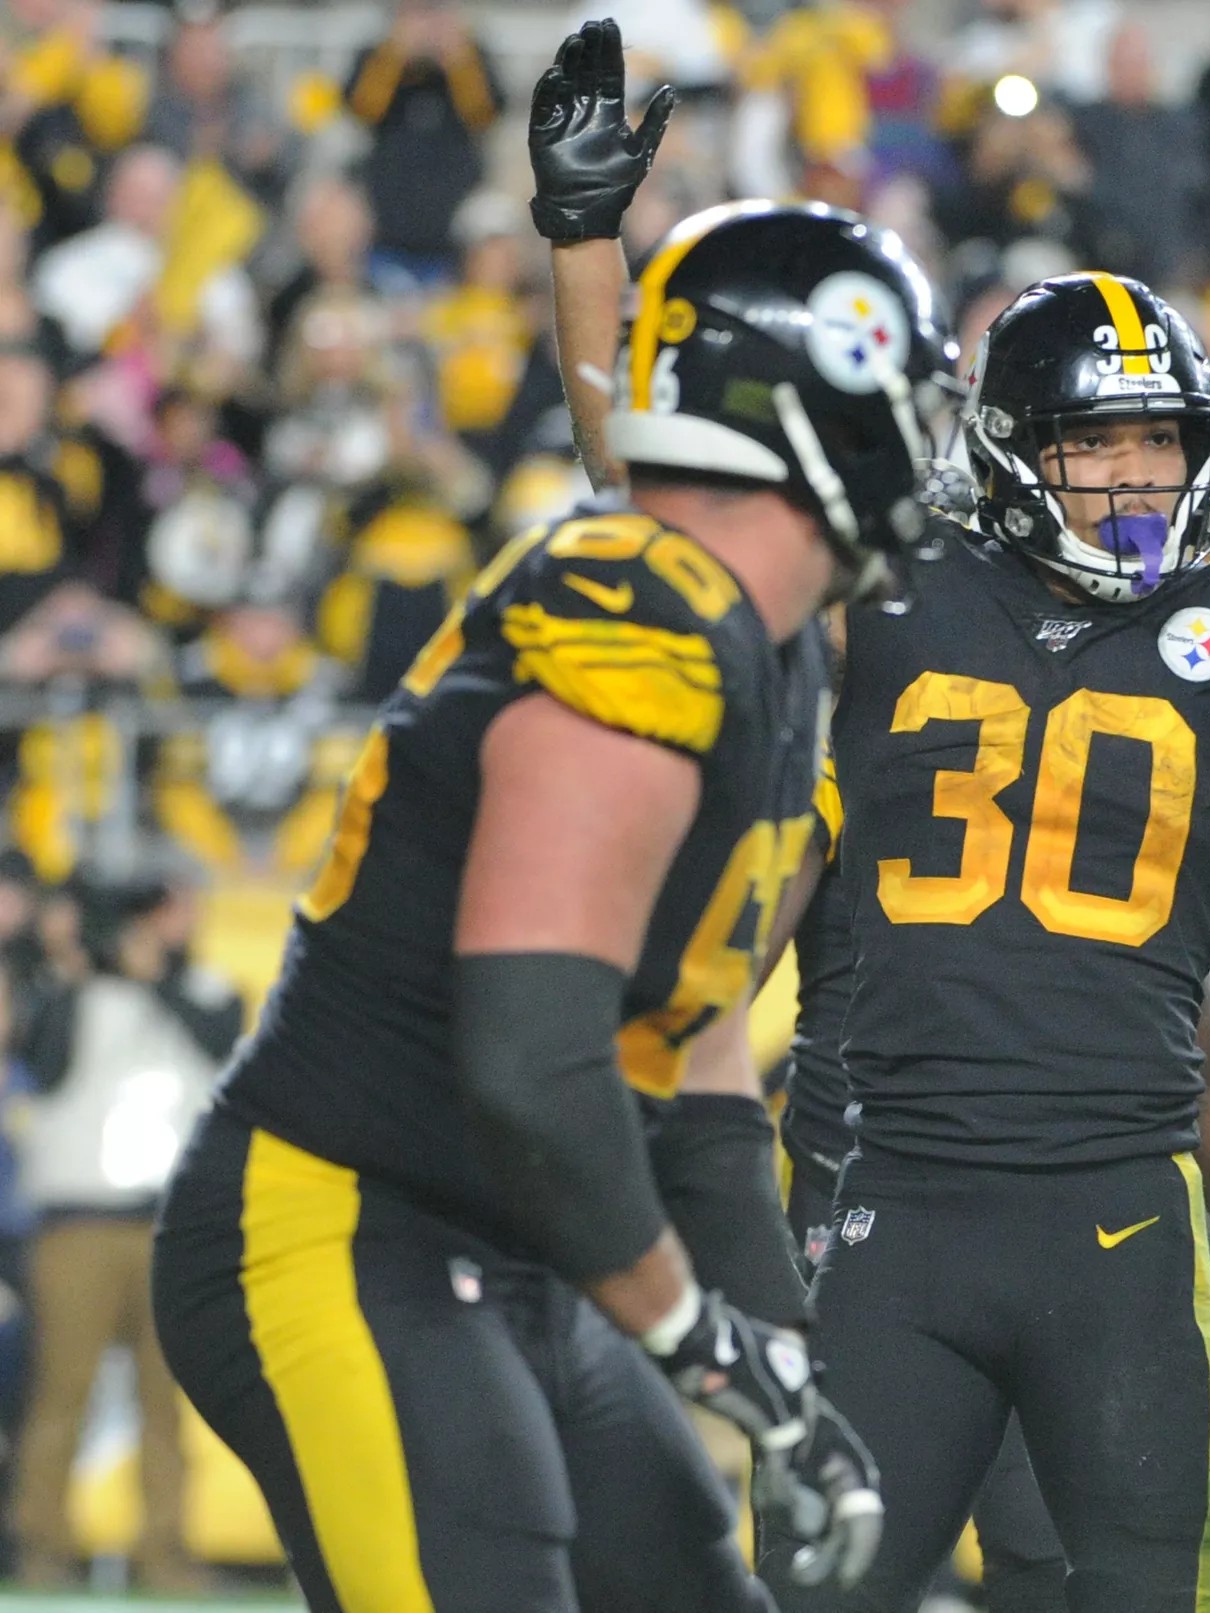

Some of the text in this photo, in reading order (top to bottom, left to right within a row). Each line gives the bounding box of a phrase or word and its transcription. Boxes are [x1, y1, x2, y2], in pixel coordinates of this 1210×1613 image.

[1093, 323, 1172, 375] 30
[1118, 377, 1162, 390] Steelers
[877, 670, 1197, 948] 30
